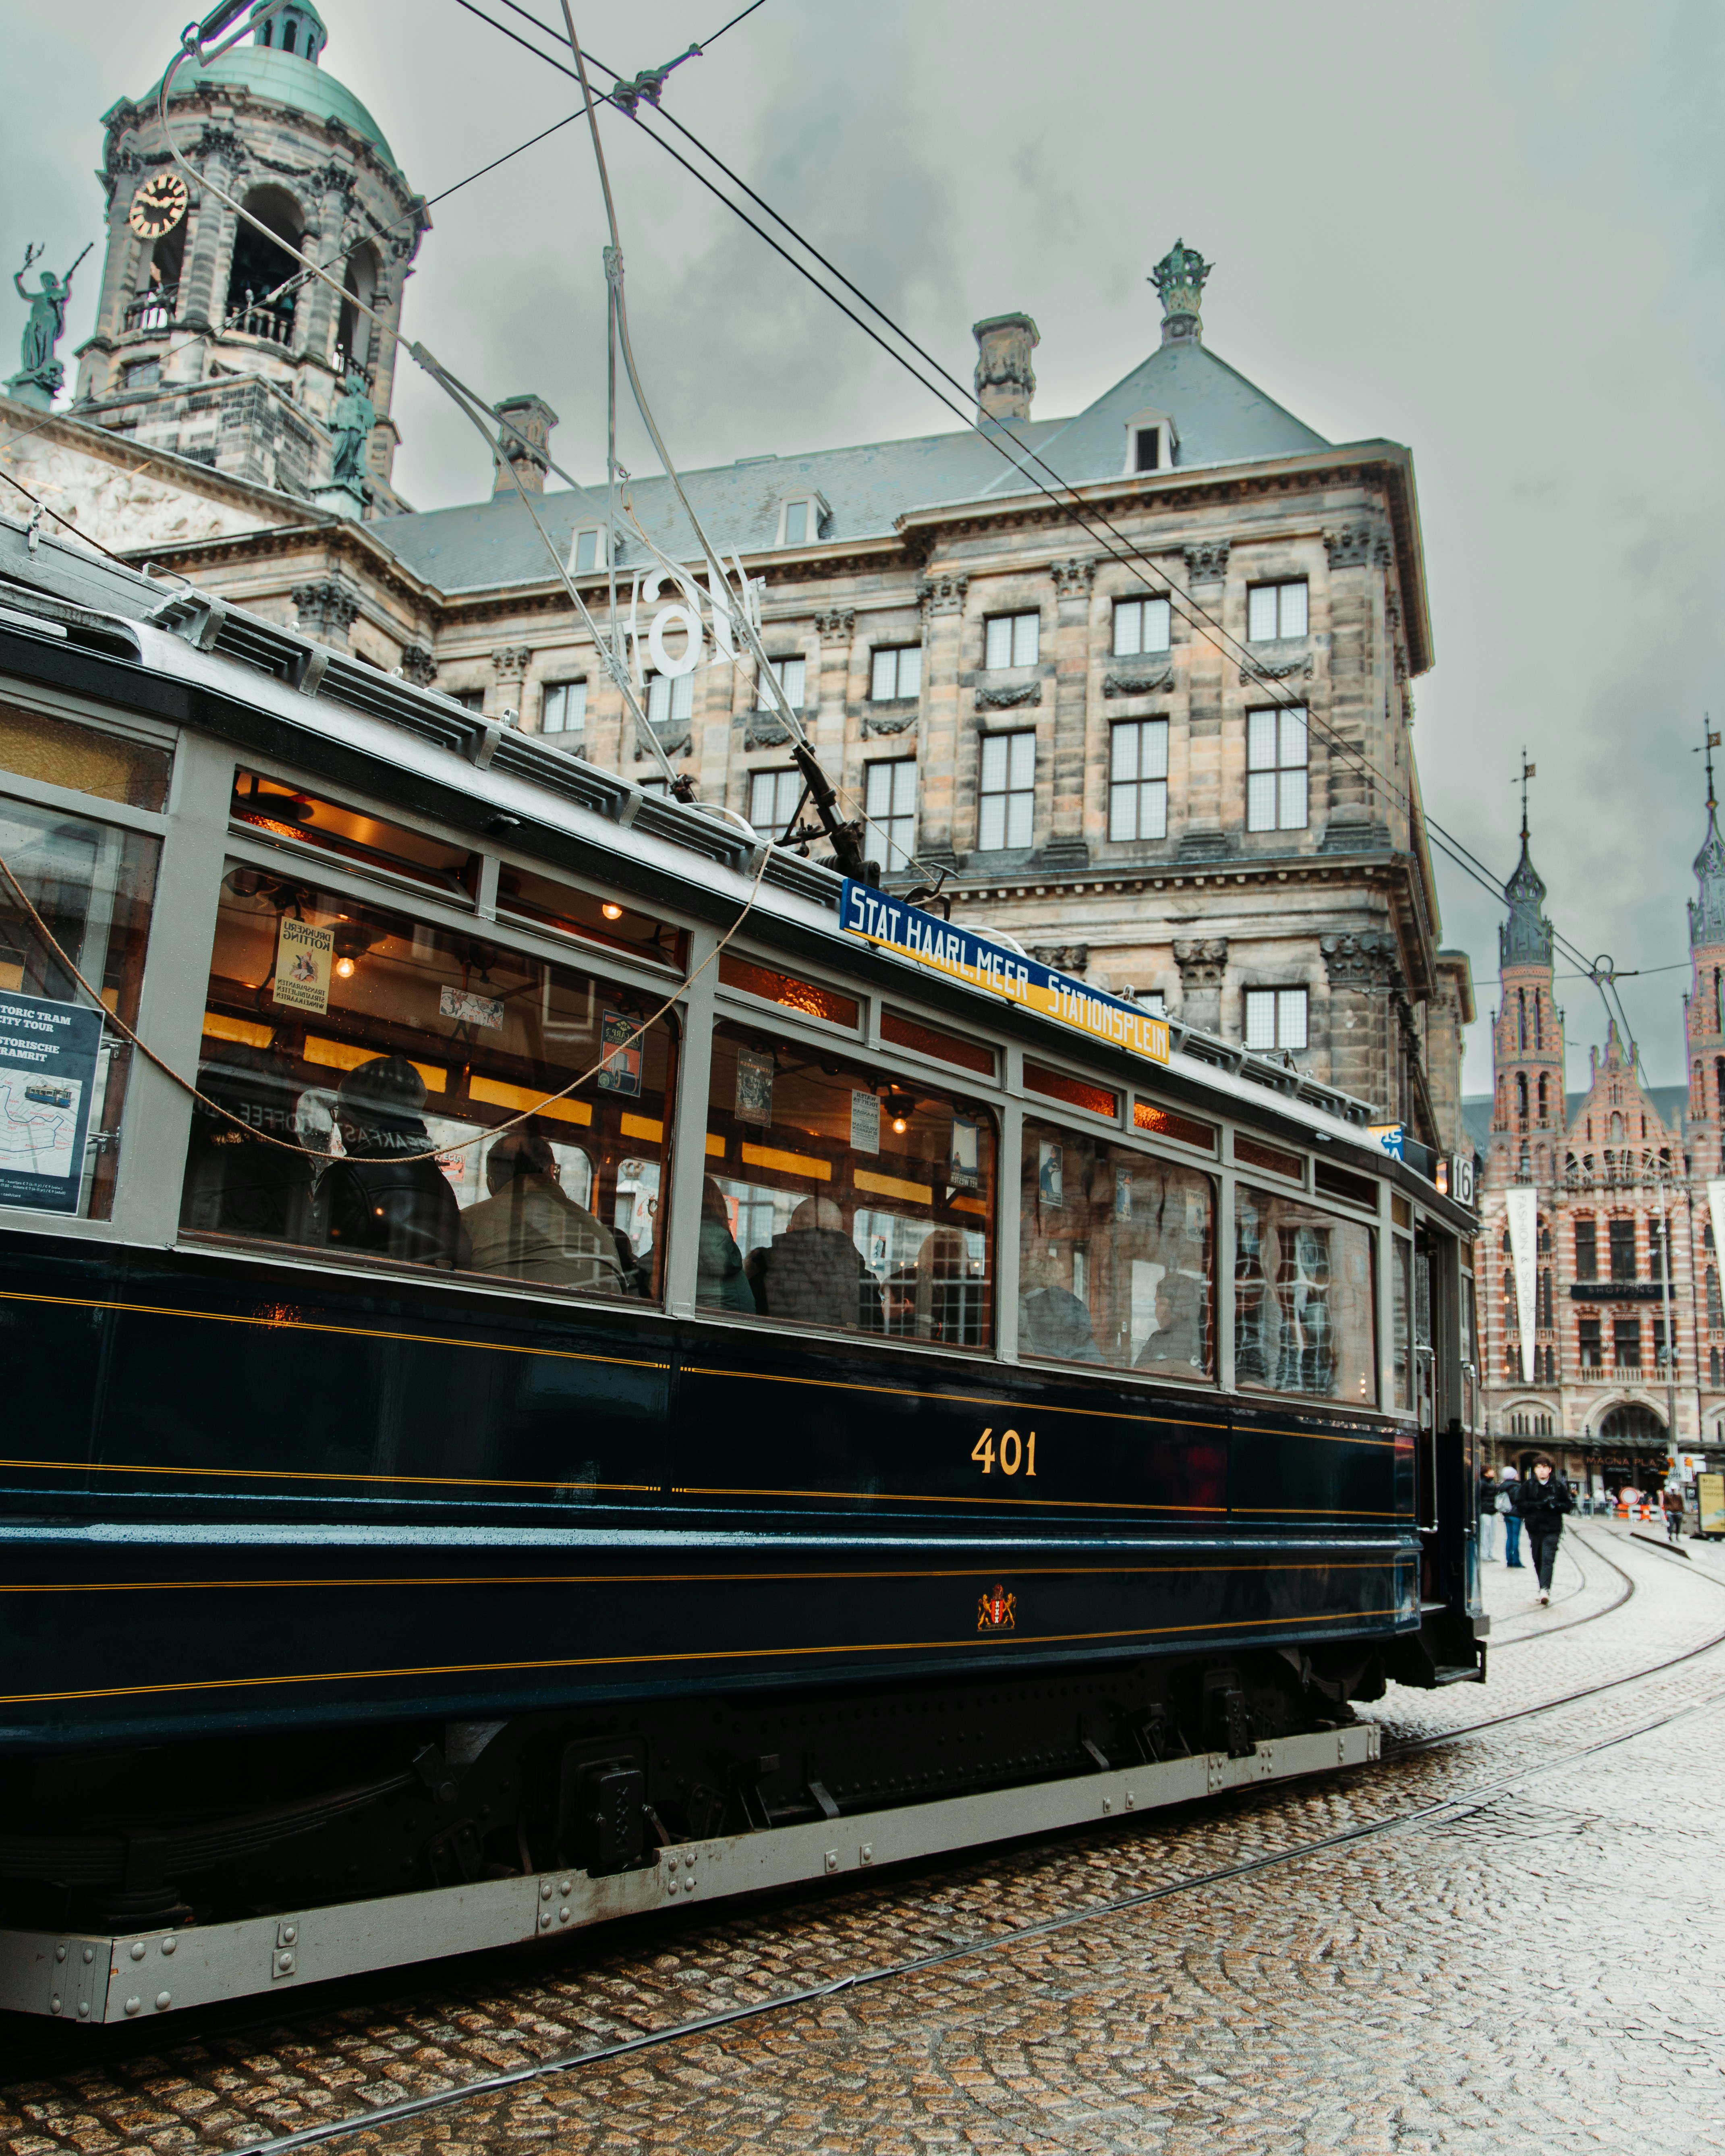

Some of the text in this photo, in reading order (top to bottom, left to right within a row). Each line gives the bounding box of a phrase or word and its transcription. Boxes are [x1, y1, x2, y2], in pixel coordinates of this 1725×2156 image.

[0, 1005, 71, 1025] TORIC TRAM
[23, 1020, 54, 1032] TOUR
[1048, 976, 1166, 1059] STATIONSPLEIN
[0, 1047, 47, 1062] RAMRIT
[1455, 1159, 1470, 1201] 16
[1518, 1195, 1529, 1249] FASHION
[1522, 1272, 1533, 1336] SHOPPING
[971, 1428, 1036, 1476] 401
[1586, 1456, 1630, 1466] MAGNA
